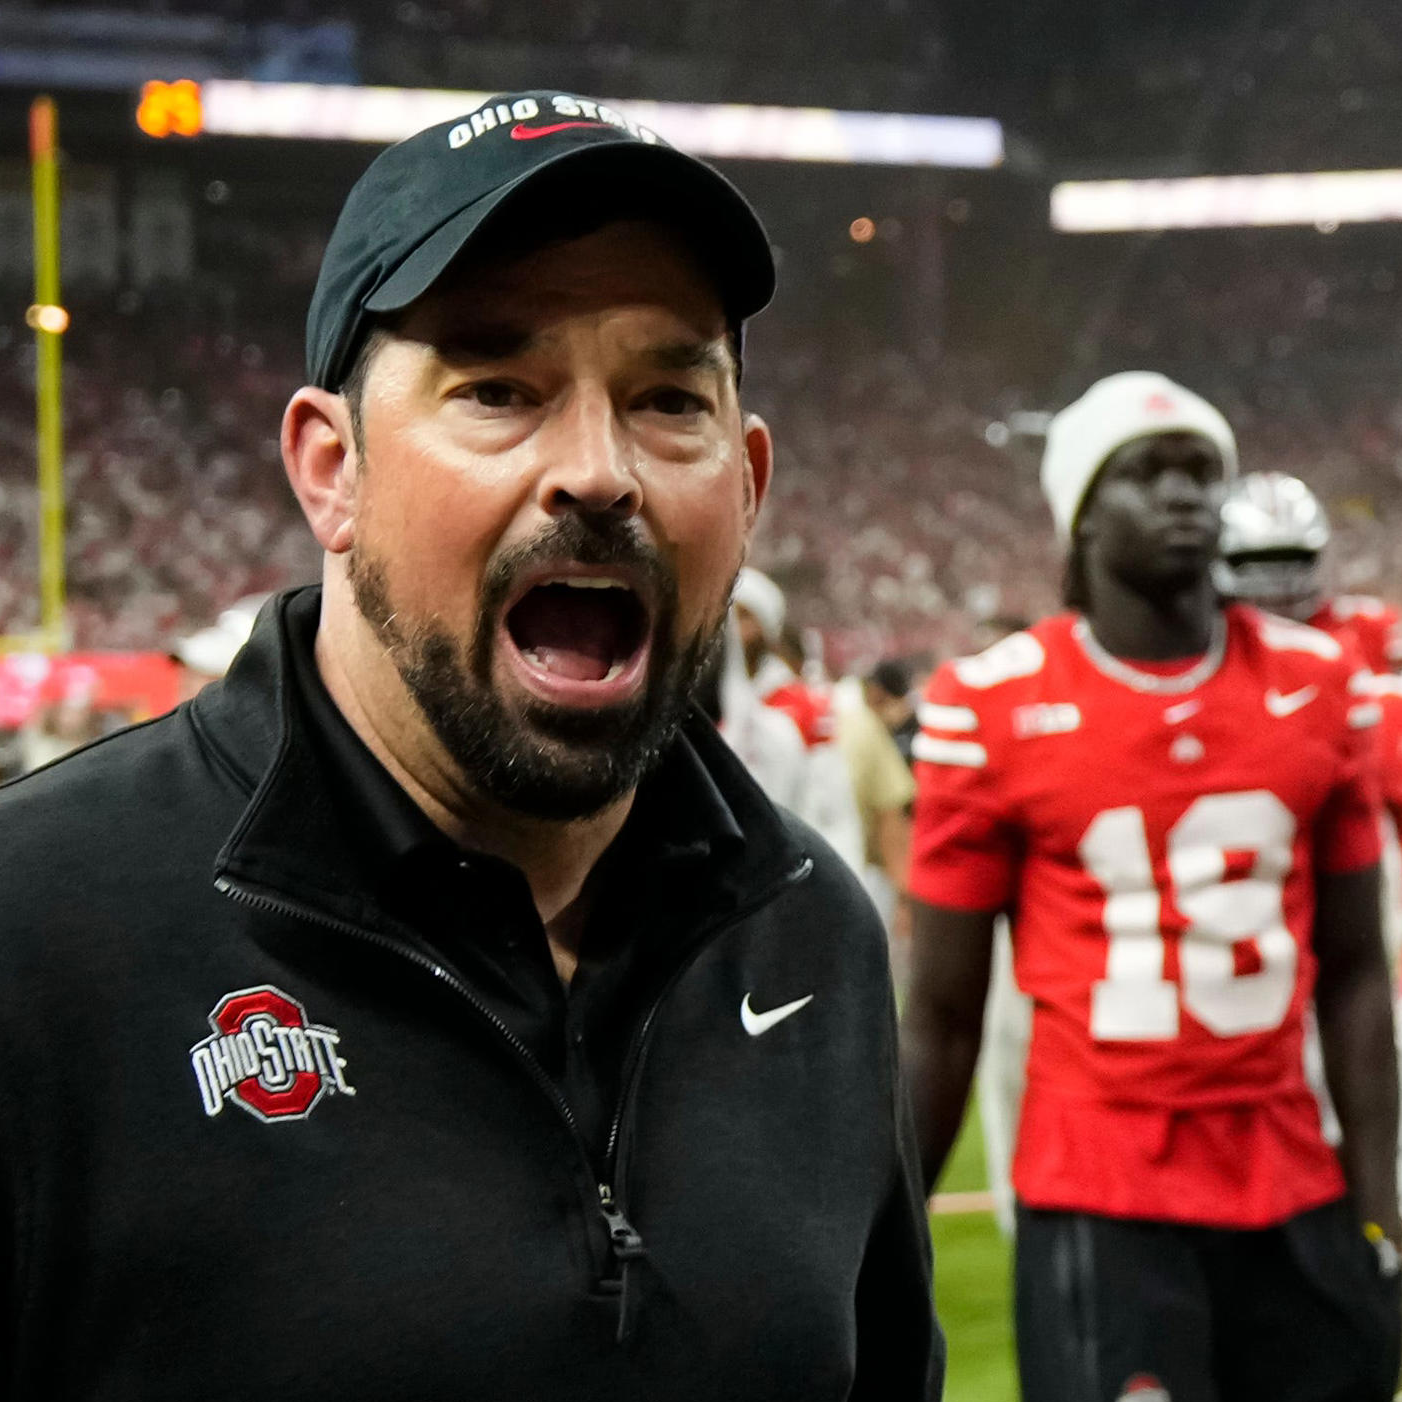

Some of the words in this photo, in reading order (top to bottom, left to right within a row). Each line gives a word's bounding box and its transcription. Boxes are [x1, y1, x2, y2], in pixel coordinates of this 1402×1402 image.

[448, 98, 539, 149] OHIO
[1079, 789, 1297, 1041] 18
[192, 1032, 261, 1117] OHIO
[250, 1020, 357, 1096] STATE
